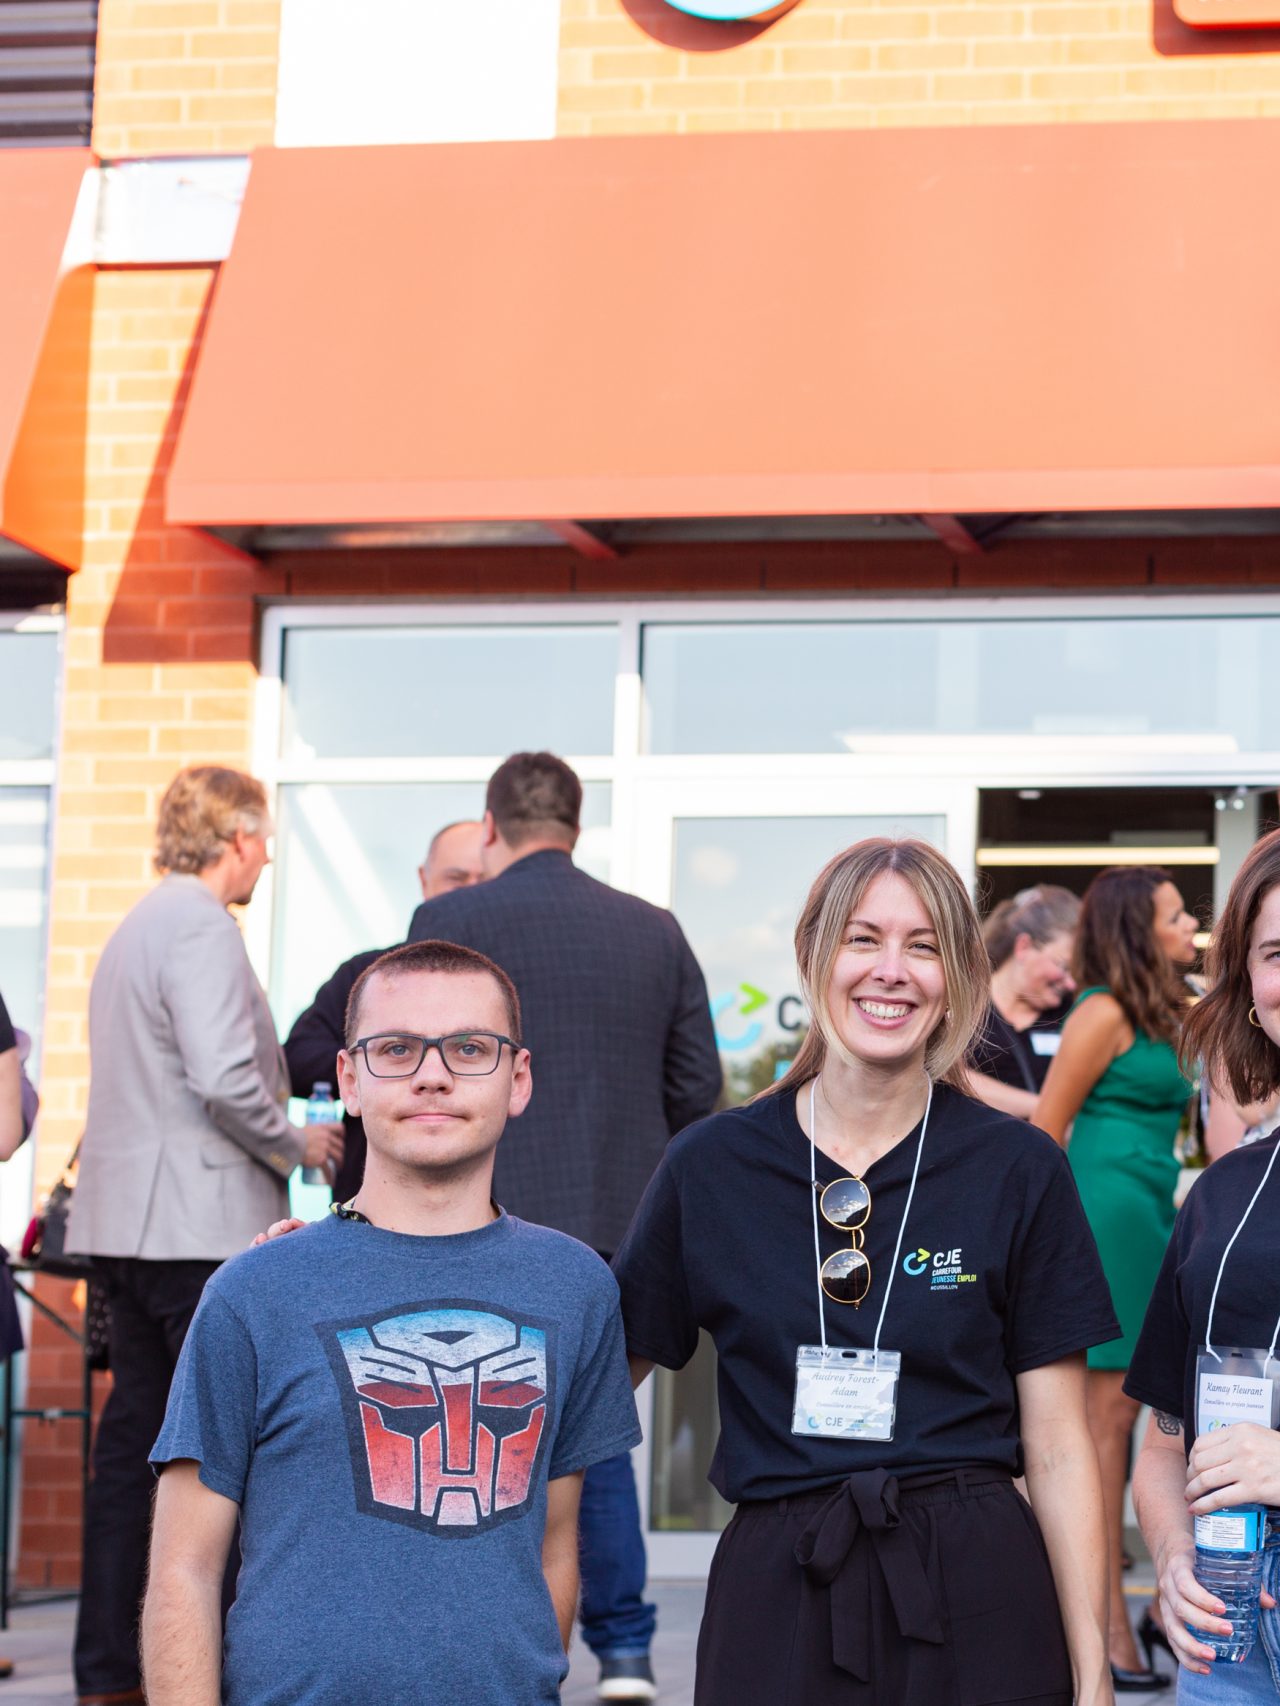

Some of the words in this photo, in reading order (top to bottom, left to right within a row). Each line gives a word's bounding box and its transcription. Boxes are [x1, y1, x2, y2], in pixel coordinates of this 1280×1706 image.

[933, 1248, 962, 1267] CJE
[932, 1266, 962, 1276] CARREFOUR
[931, 1274, 957, 1284] JEUNESSE
[957, 1274, 977, 1283] EMPLOI
[812, 1371, 845, 1384] Audrey
[847, 1373, 880, 1384] Forest-
[831, 1387, 859, 1397] Adam
[1232, 1385, 1263, 1395] Fleurant
[825, 1416, 844, 1427] CJE
